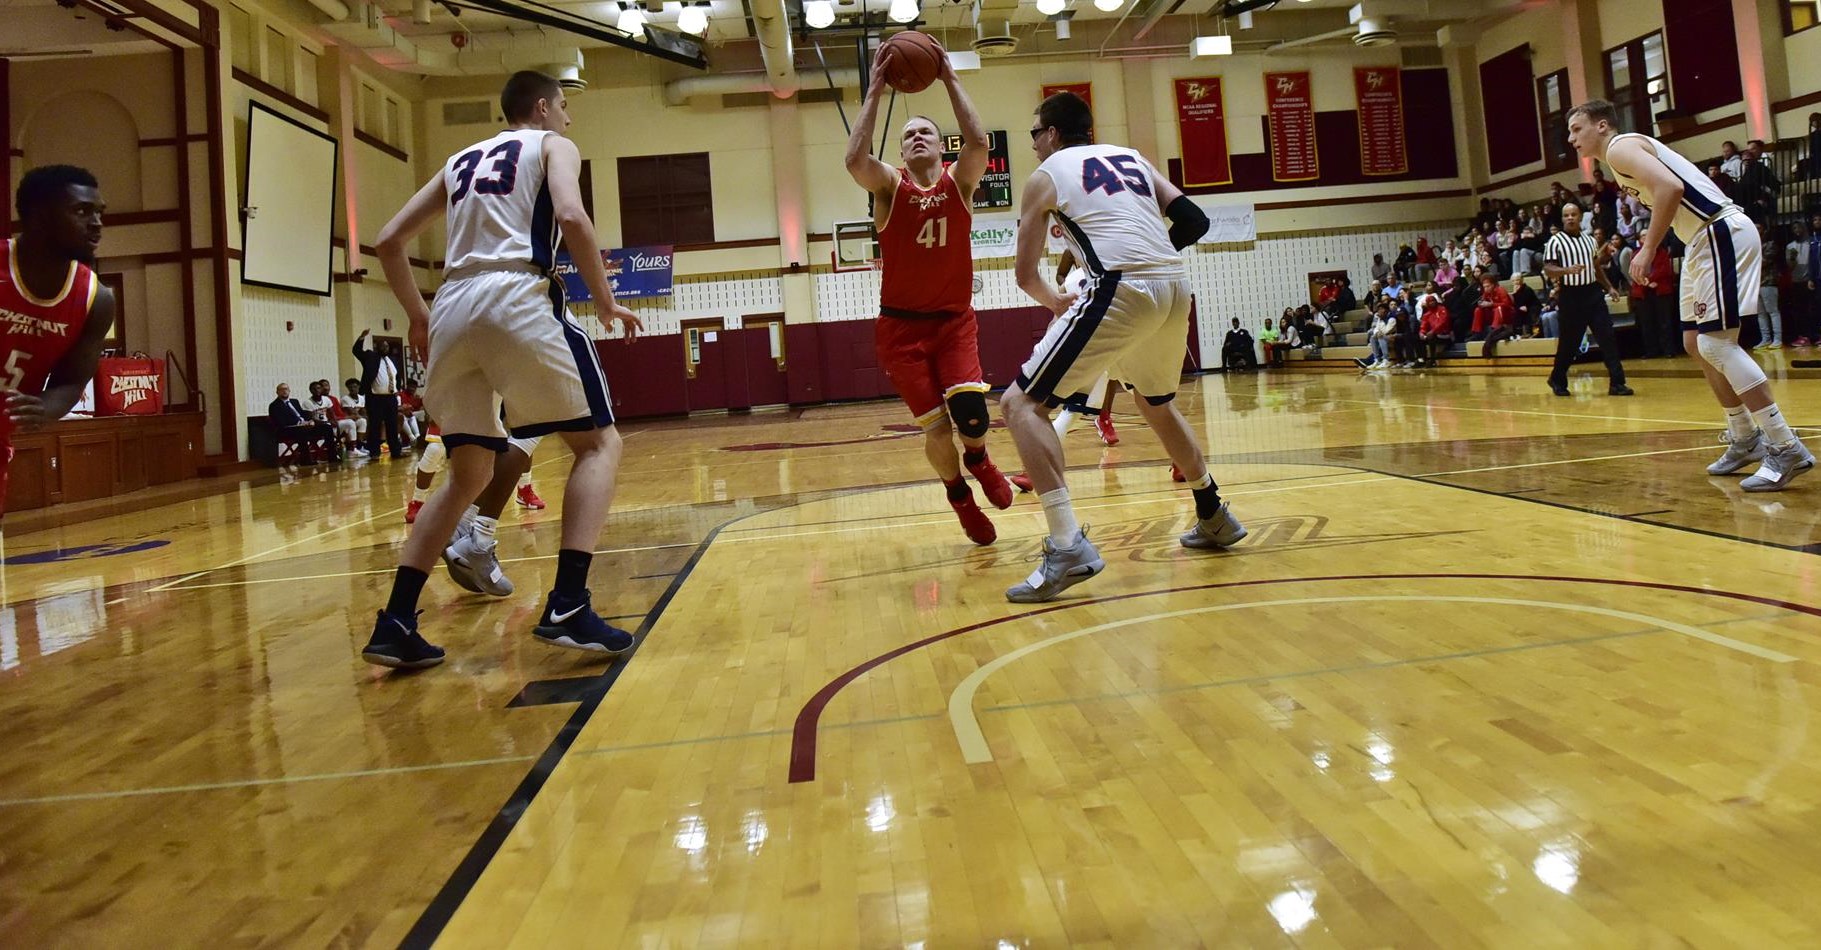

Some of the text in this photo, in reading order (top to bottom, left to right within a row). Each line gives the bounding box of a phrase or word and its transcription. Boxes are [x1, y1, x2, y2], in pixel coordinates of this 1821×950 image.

[451, 139, 523, 208] 33
[981, 173, 1010, 182] VISITOR
[1082, 154, 1152, 198] 45
[916, 216, 947, 249] 41
[971, 228, 1014, 244] Kelly's
[629, 252, 671, 272] YOURS
[110, 374, 160, 395] CHESTNUT
[123, 389, 148, 410] HILL
